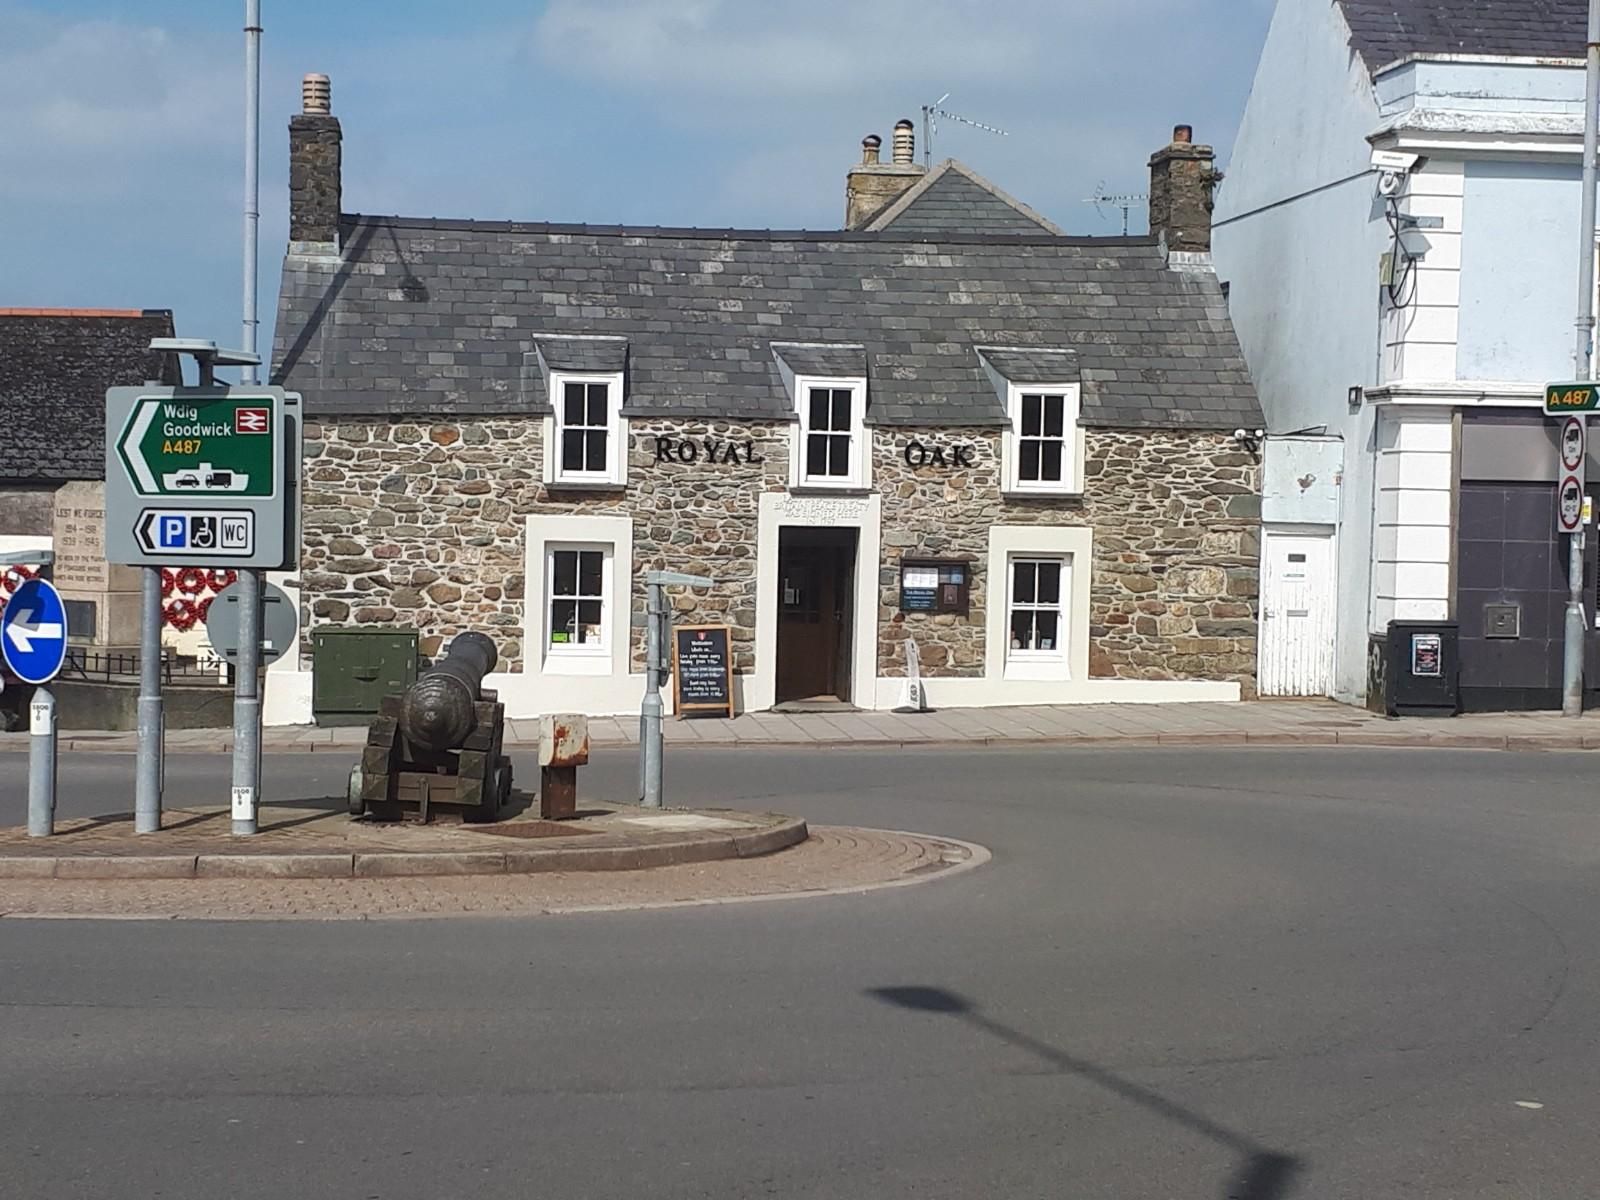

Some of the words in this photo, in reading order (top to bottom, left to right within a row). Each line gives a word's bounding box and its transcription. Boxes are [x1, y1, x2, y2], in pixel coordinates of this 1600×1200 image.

[1549, 391, 1560, 405] A
[1562, 389, 1591, 405] 487
[163, 404, 198, 421] Wdig
[163, 422, 232, 437] Goodwick
[162, 440, 201, 454] A487
[655, 436, 765, 465] ROYAL
[904, 440, 974, 468] OAK
[56, 508, 72, 518] LEST
[166, 519, 183, 545] P
[224, 524, 245, 541] WC
